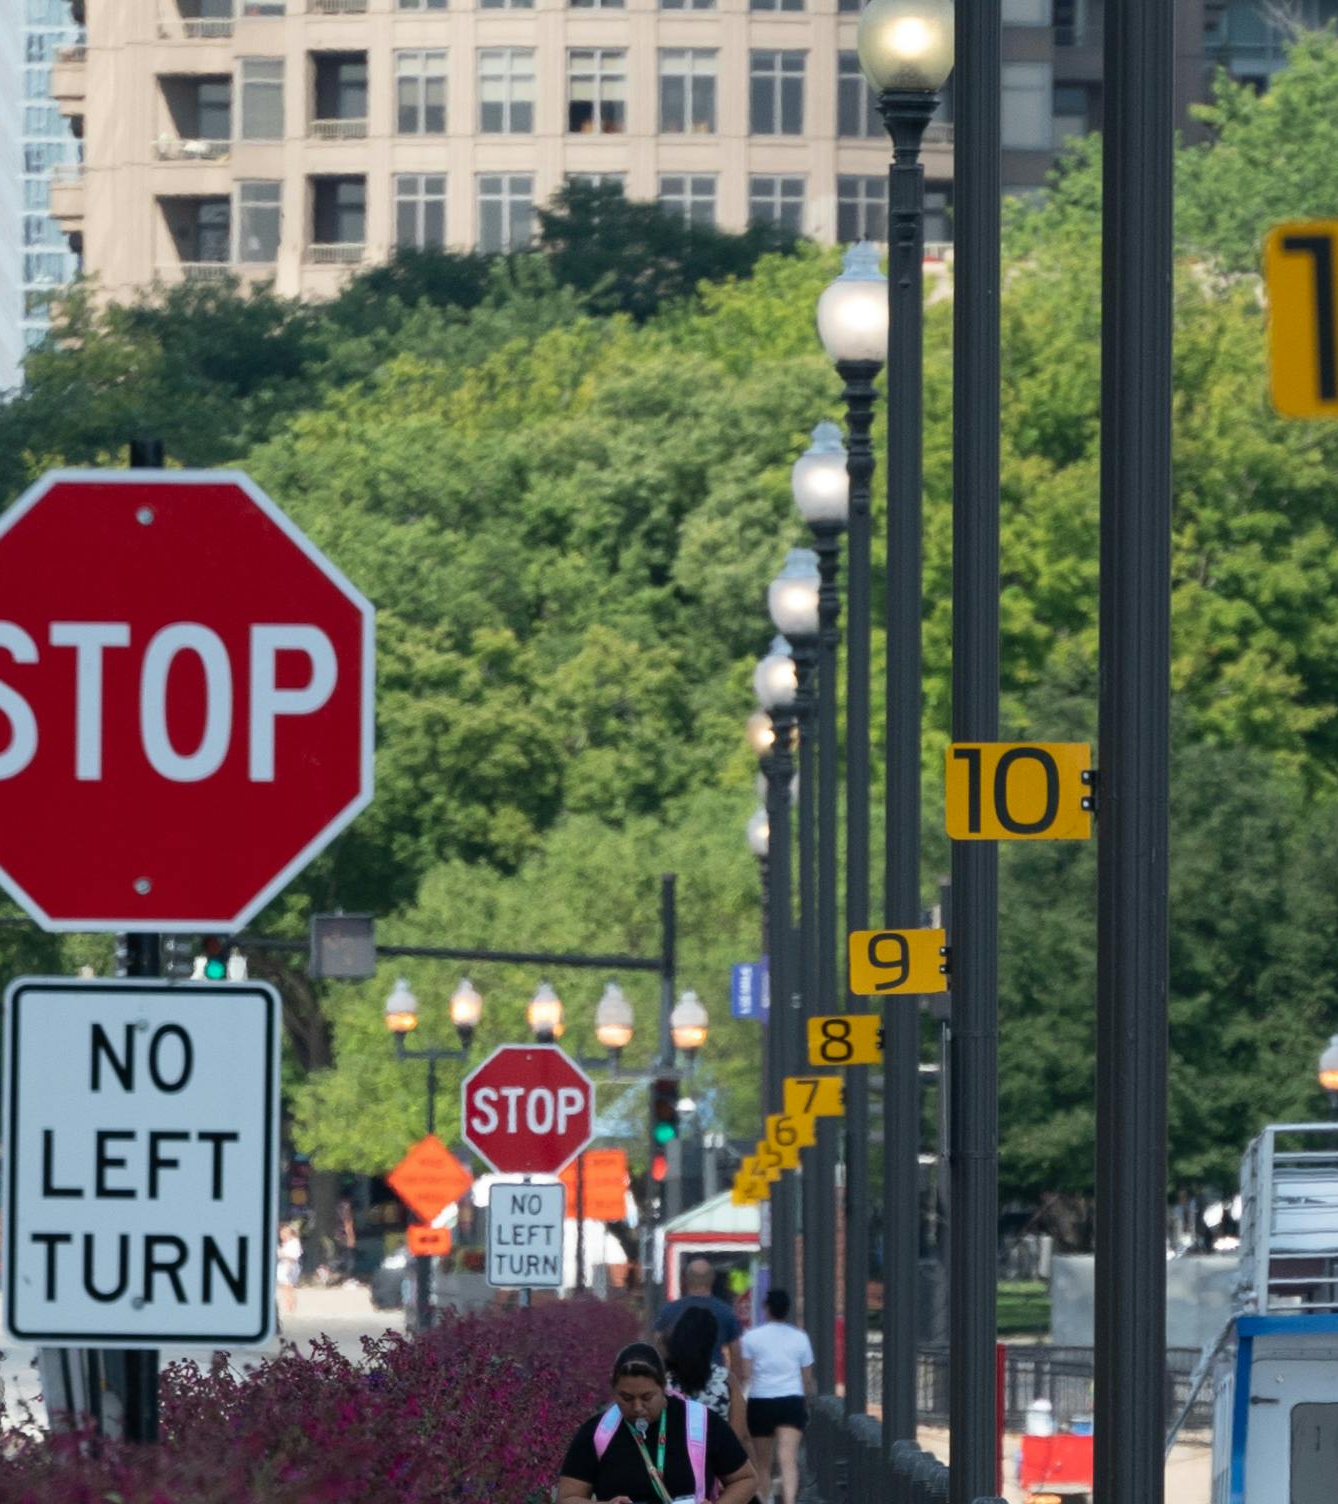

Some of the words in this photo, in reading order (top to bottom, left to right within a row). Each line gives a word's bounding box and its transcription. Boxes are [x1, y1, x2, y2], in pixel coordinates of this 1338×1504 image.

[953, 747, 1060, 835] 10
[867, 932, 911, 991] 9
[90, 1022, 194, 1093] NO
[820, 1019, 854, 1063] 8
[471, 1087, 585, 1135] STOP
[796, 1080, 820, 1114] 7
[774, 1116, 798, 1146] 6
[42, 1129, 239, 1200] LEFT
[511, 1194, 542, 1216] NO
[496, 1225, 555, 1246] LEFT
[30, 1232, 249, 1304] TURN
[495, 1254, 558, 1276] TURN
